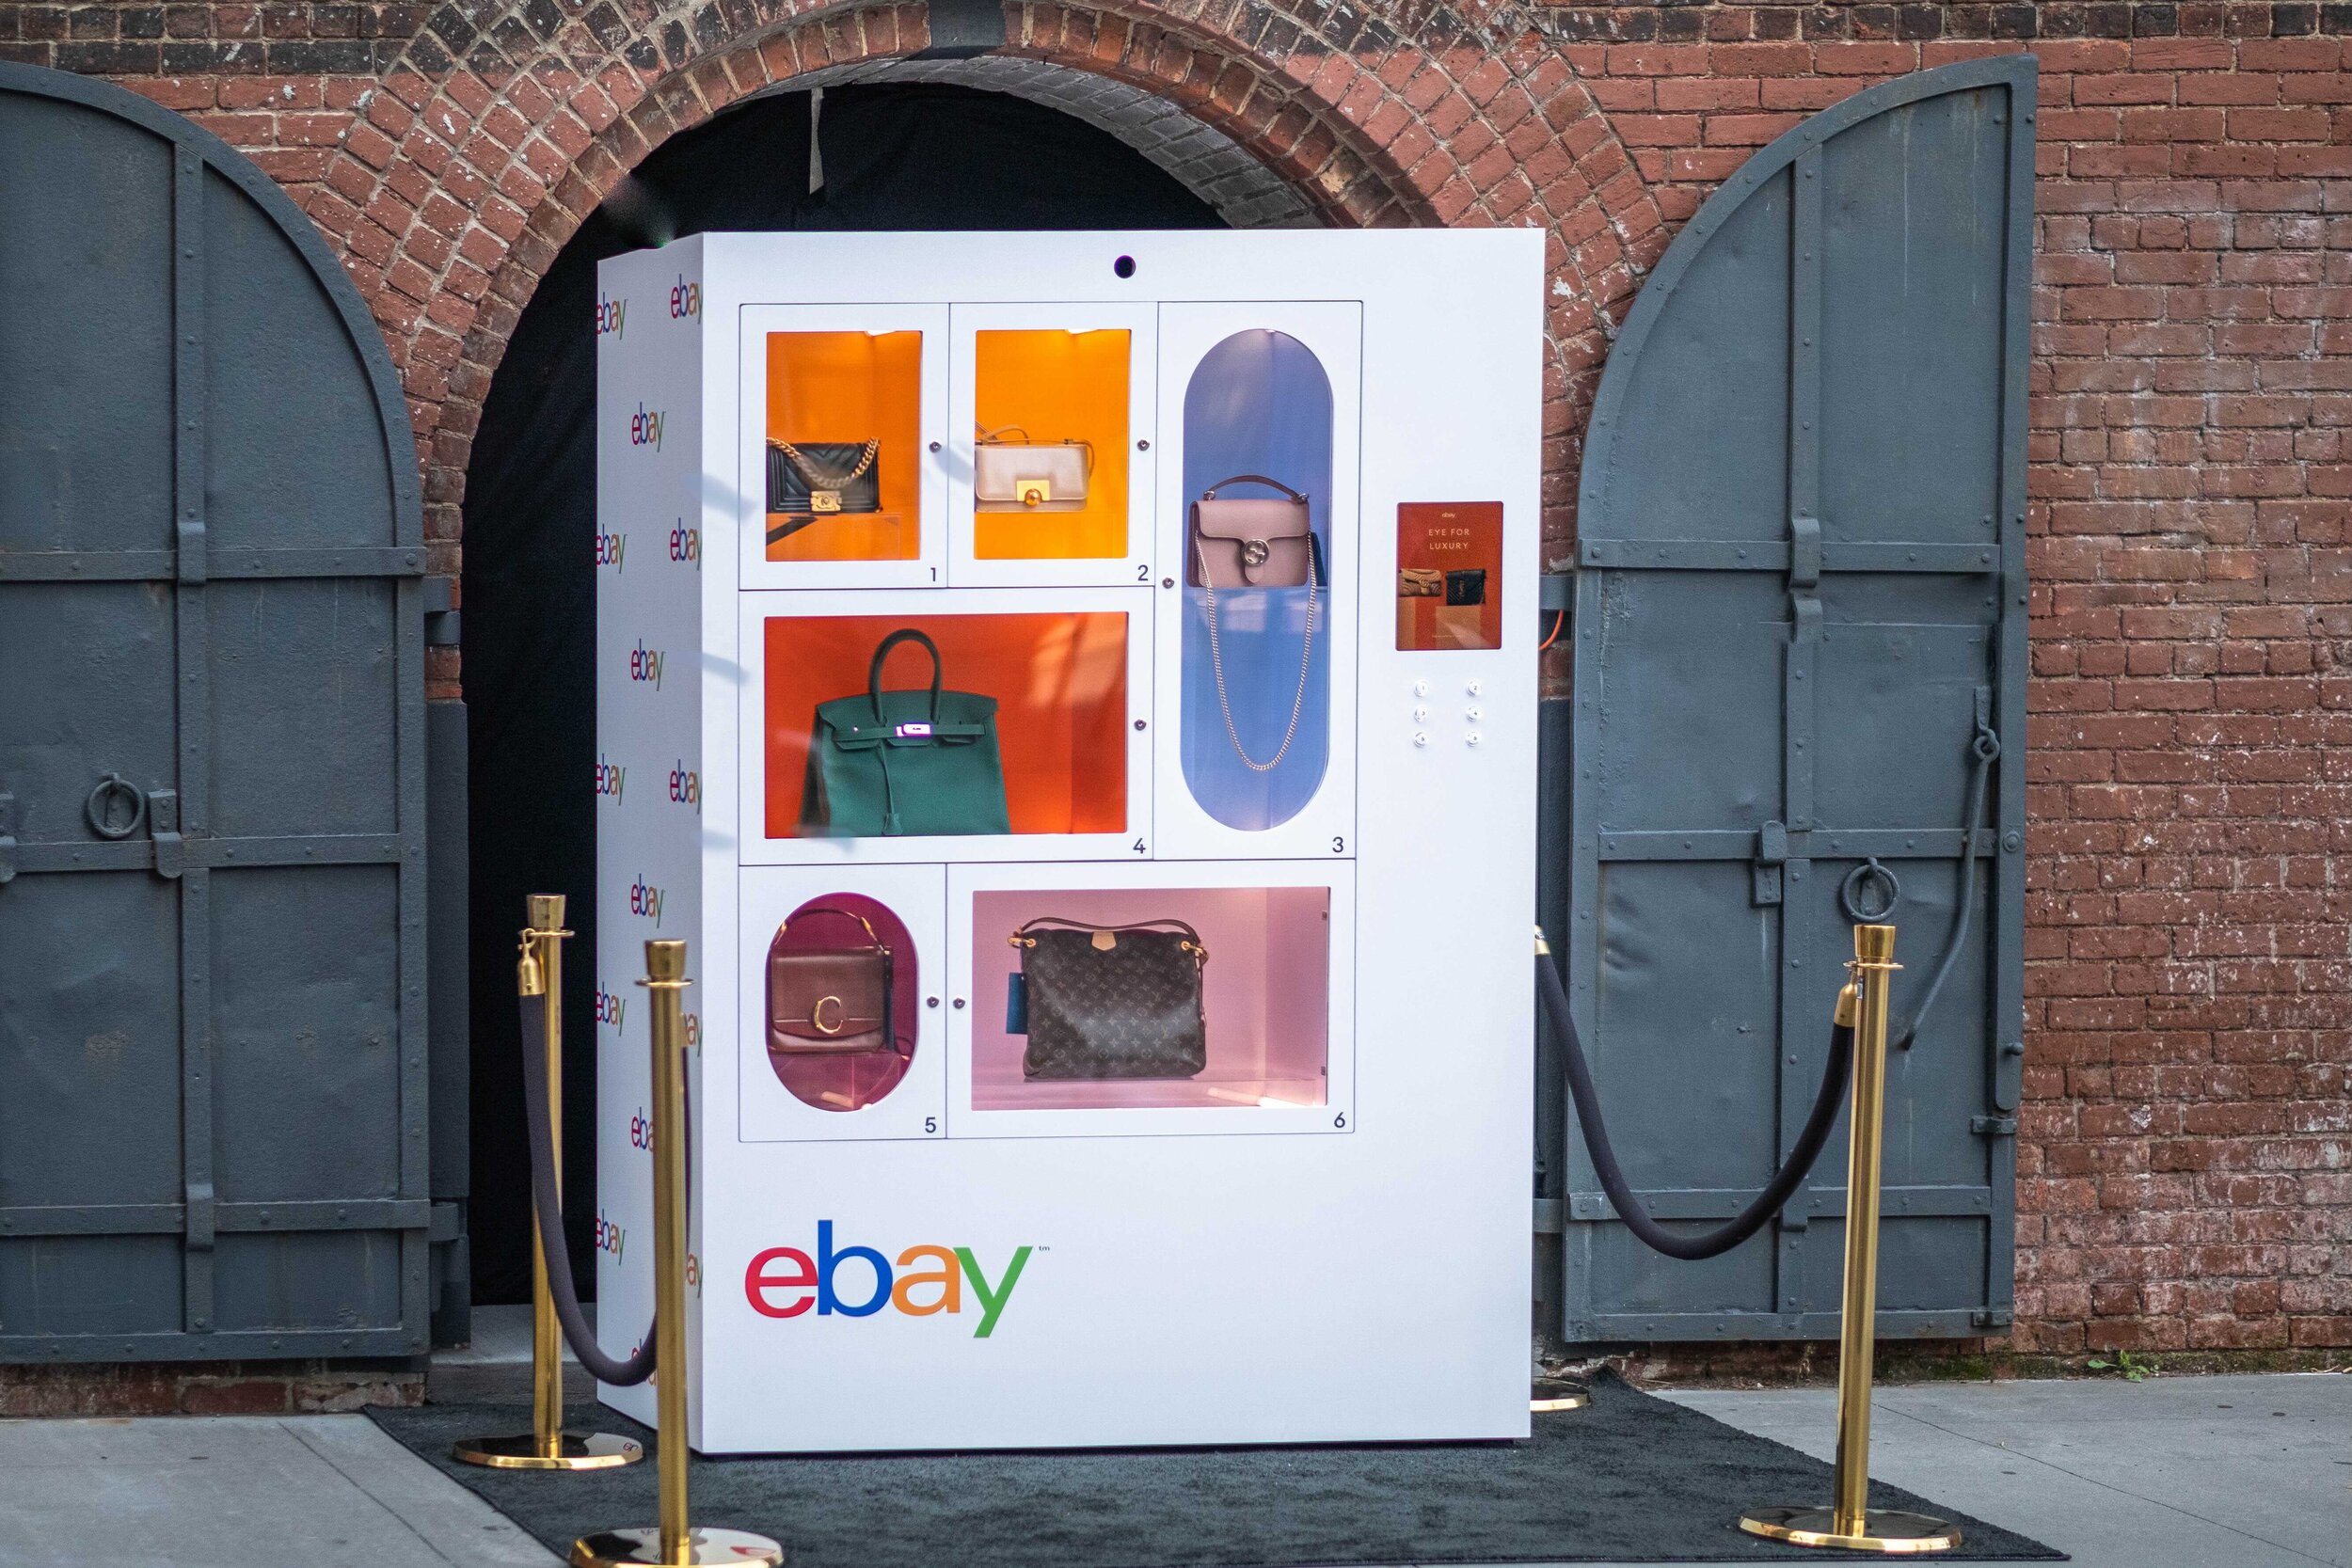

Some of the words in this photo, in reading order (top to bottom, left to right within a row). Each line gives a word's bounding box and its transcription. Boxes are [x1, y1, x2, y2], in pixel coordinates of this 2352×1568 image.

[632, 402, 665, 452] ebay
[1451, 528, 1470, 536] FOR
[930, 568, 937, 581] 1
[1137, 565, 1149, 581] 2
[631, 638, 665, 691] ebay
[1133, 838, 1147, 854] 4
[1332, 837, 1343, 853] 3
[631, 873, 665, 928] ebay
[925, 1117, 937, 1133] 5
[1334, 1112, 1346, 1129] 6
[745, 1219, 1033, 1338] ebay
